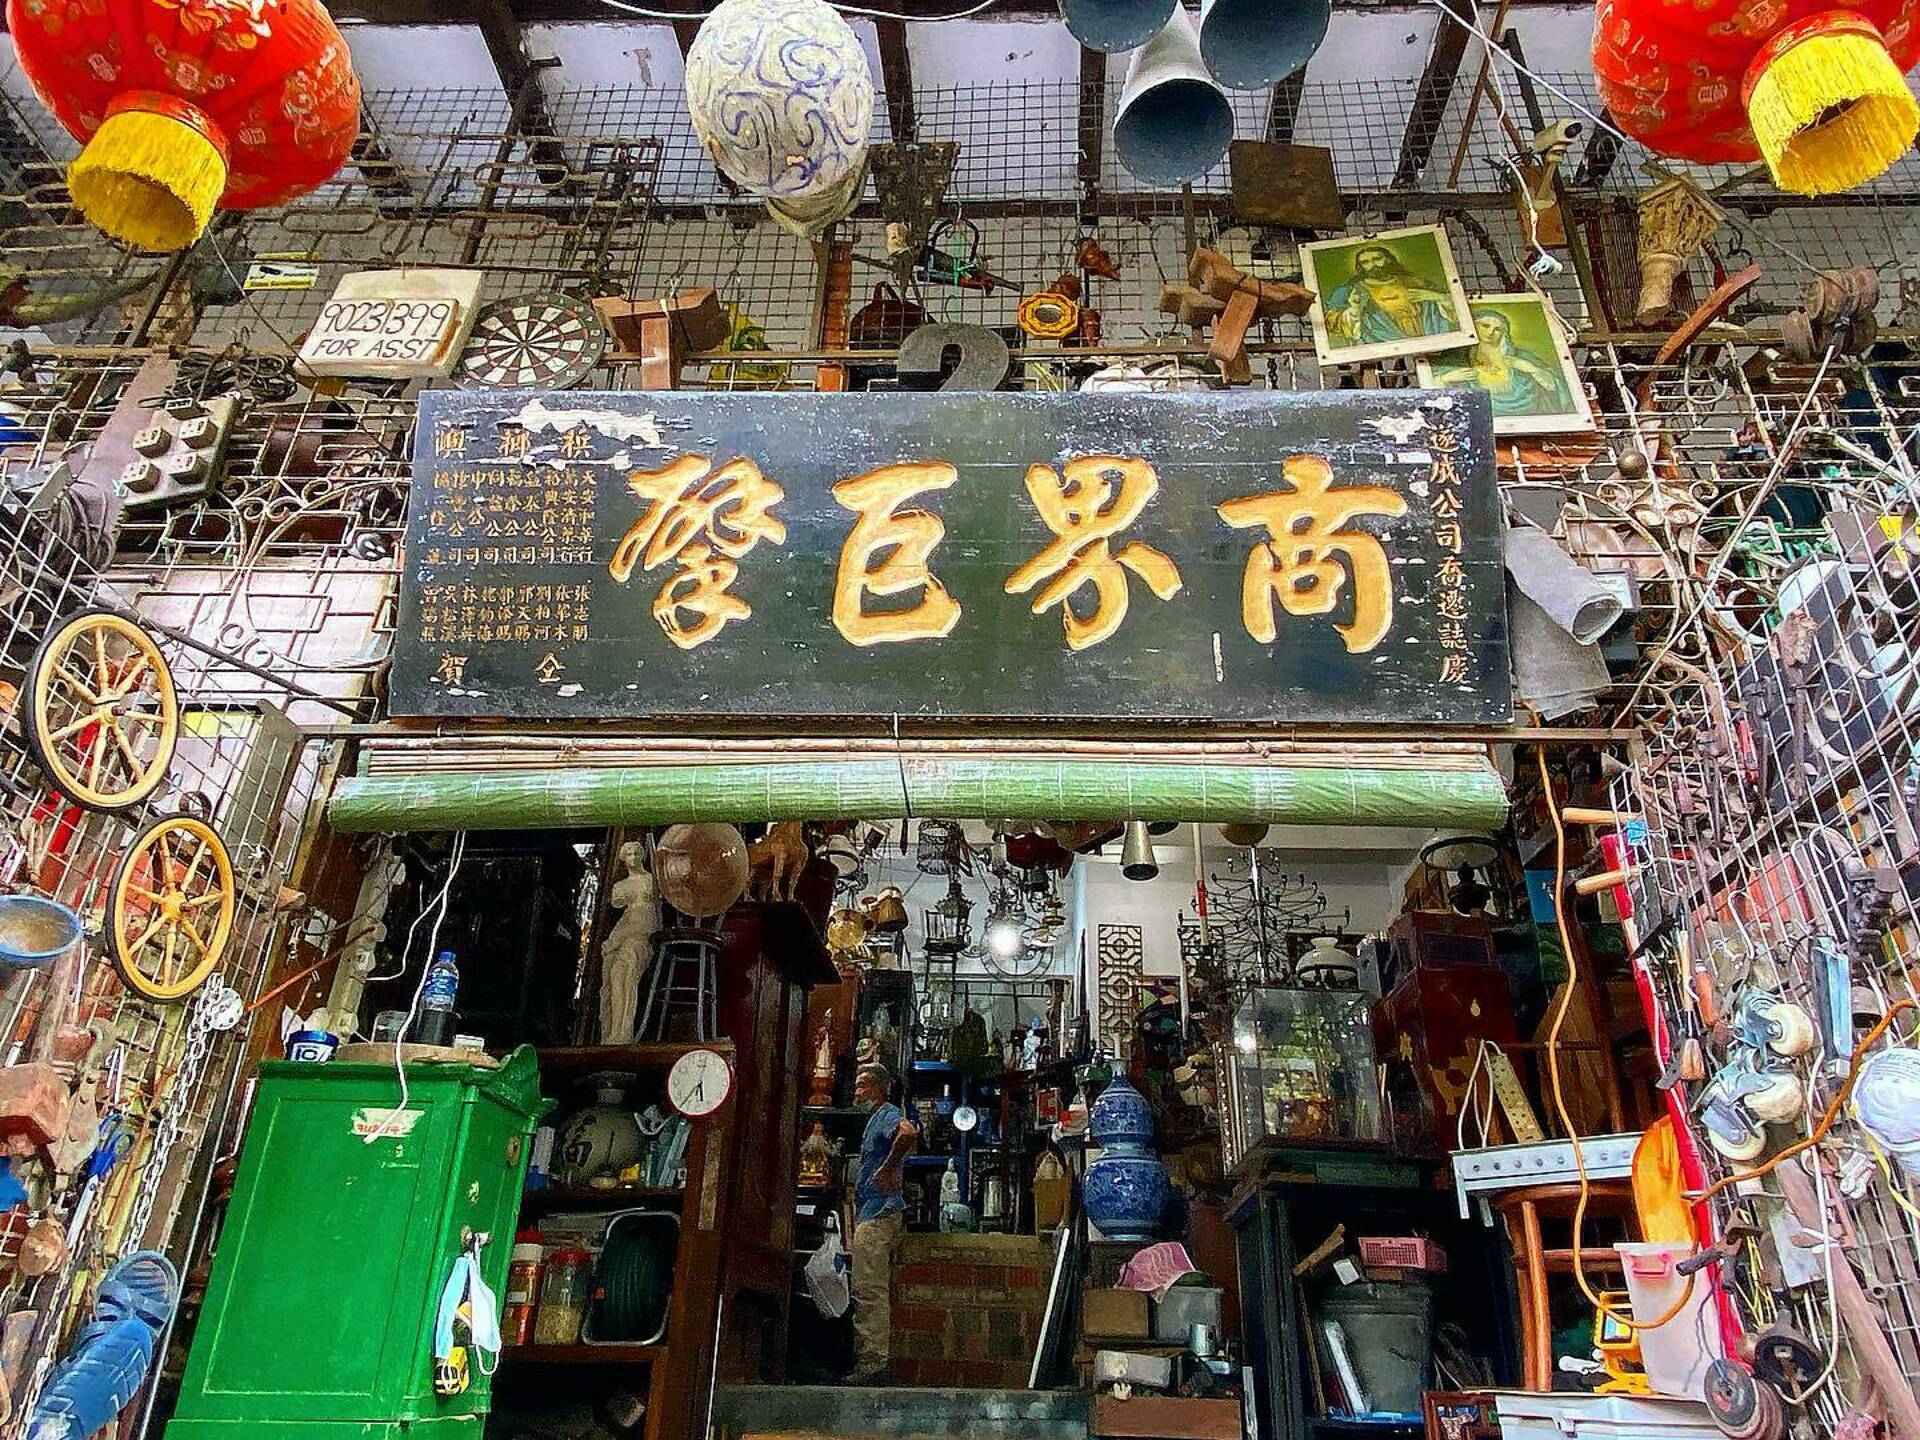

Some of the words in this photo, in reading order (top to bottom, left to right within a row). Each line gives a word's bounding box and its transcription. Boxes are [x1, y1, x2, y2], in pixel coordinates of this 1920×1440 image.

[324, 301, 450, 338] 90231399
[311, 338, 360, 356] FOR
[364, 338, 438, 359] ASST
